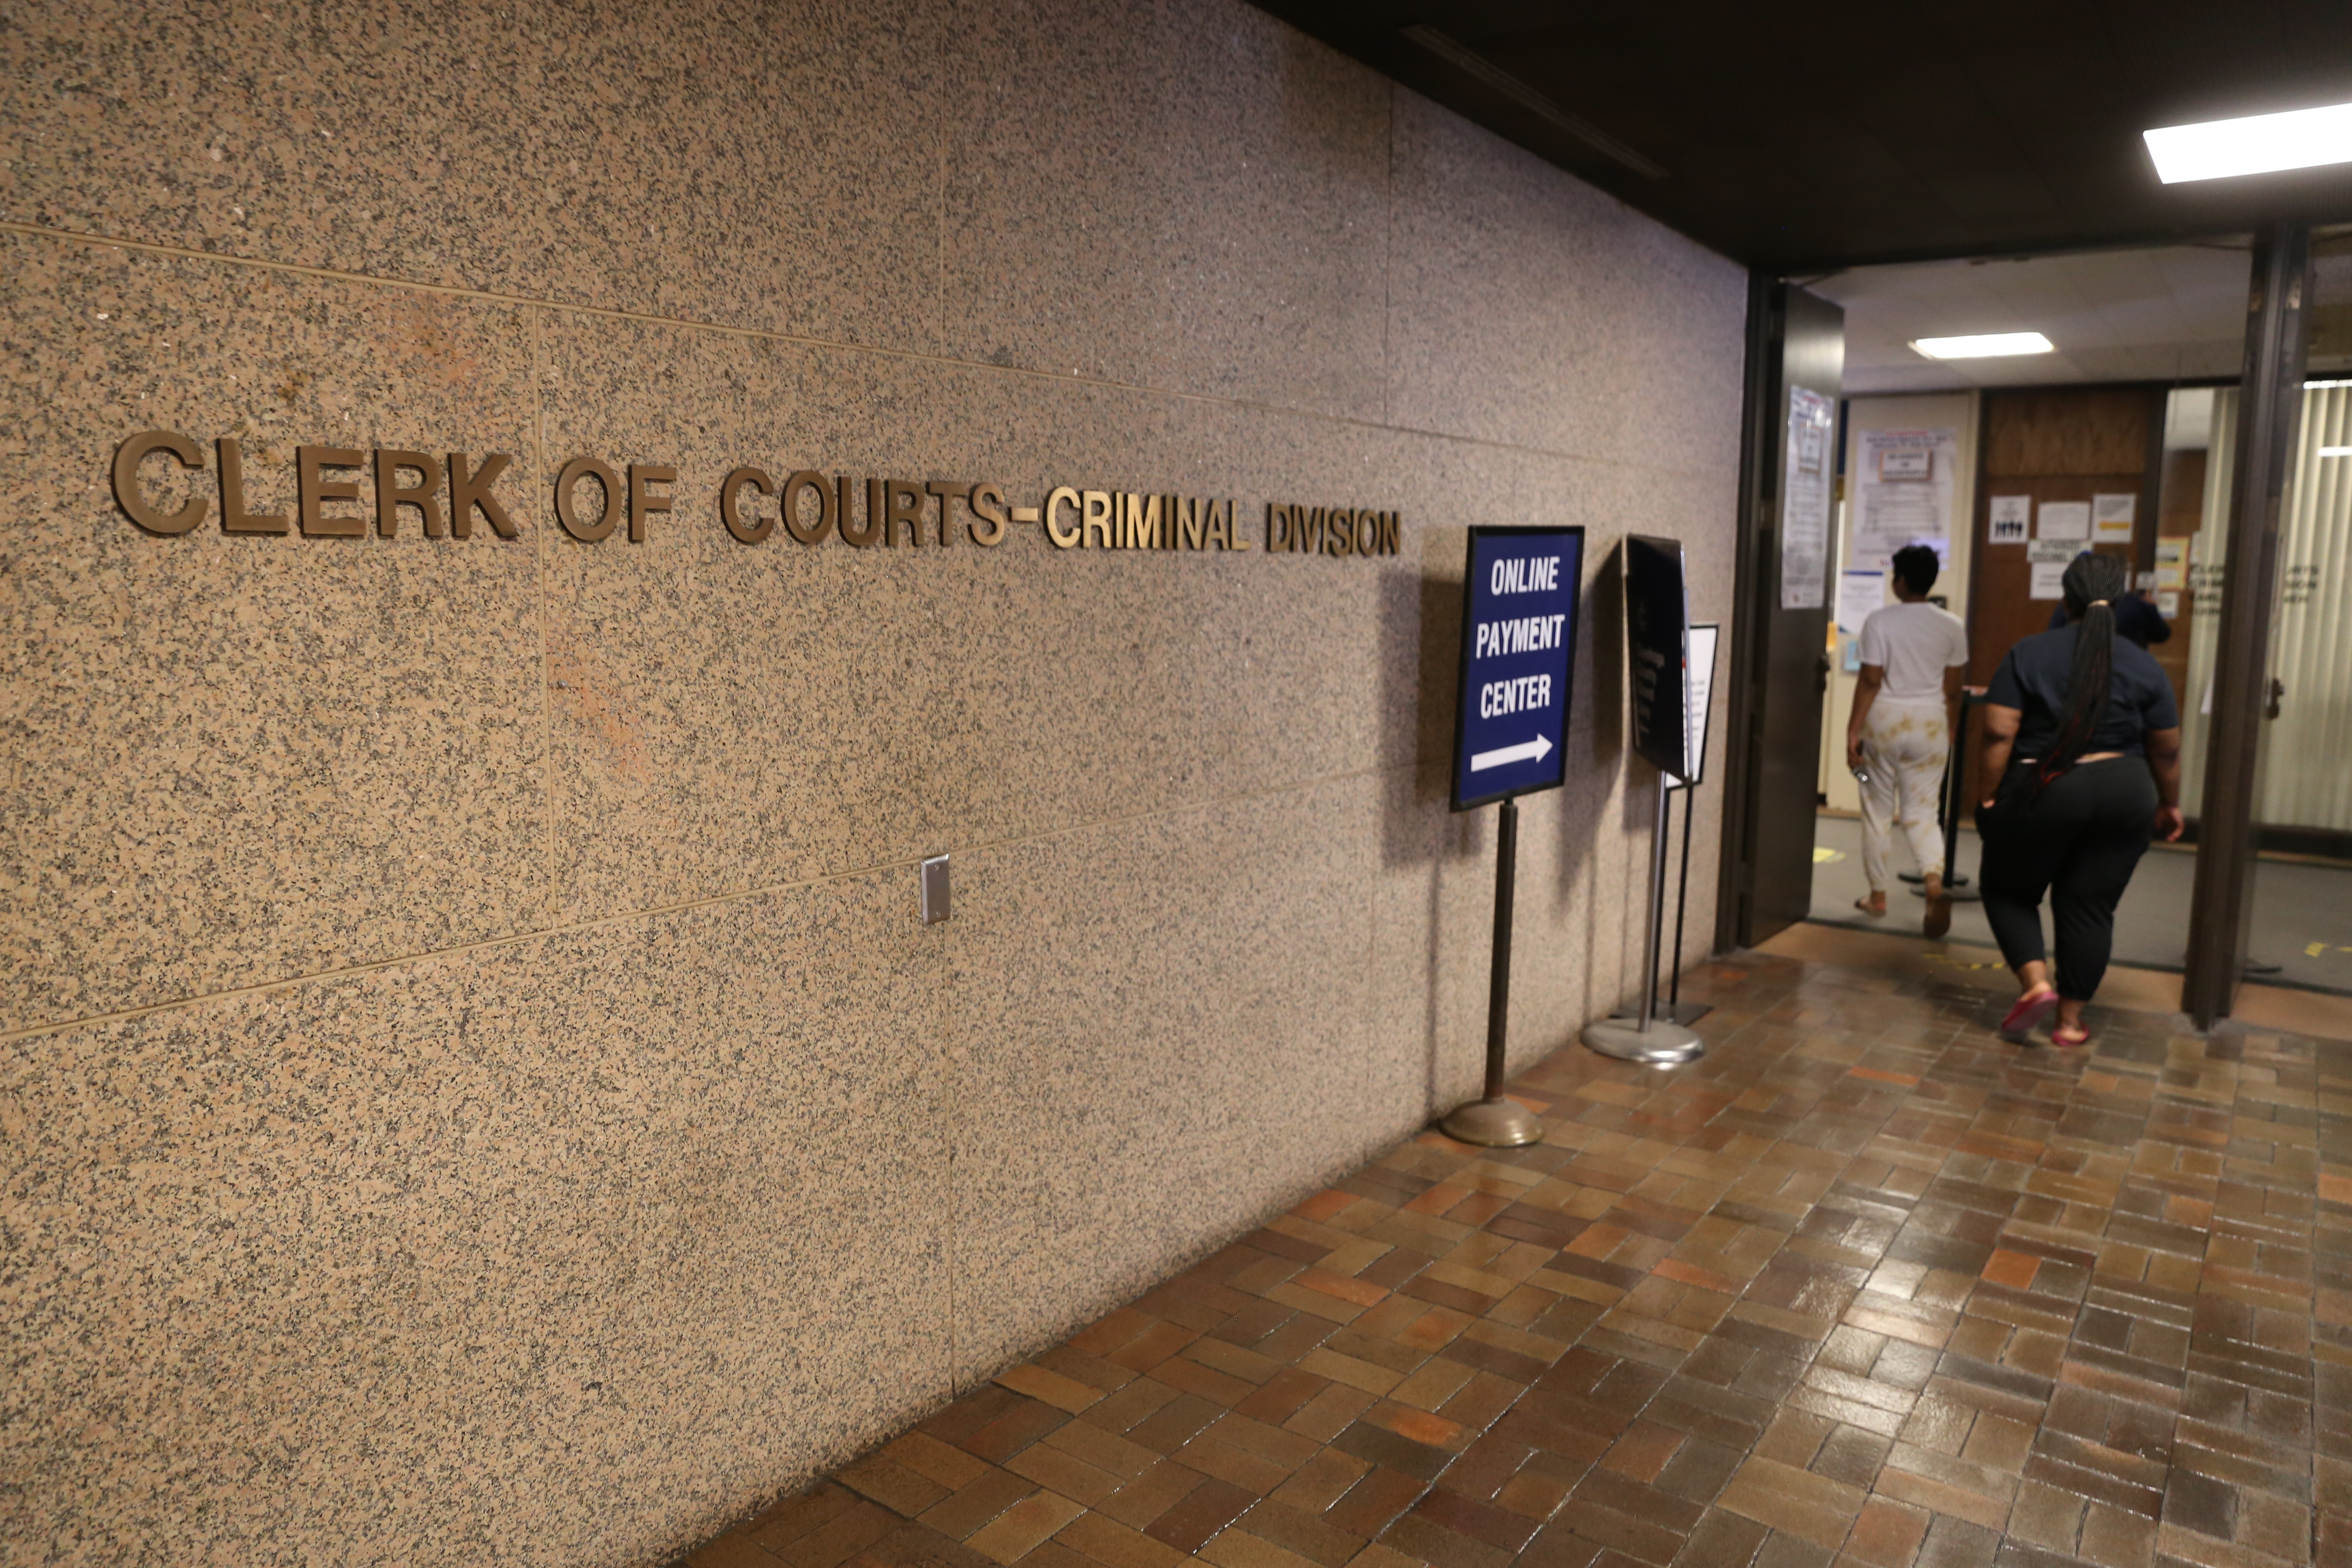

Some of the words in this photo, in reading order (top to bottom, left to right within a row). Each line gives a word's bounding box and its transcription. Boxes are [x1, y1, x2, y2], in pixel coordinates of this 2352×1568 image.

[112, 430, 518, 538] CLERK
[554, 456, 677, 542] OF
[1267, 503, 1401, 557] DIVISION
[1491, 557, 1559, 596] ONLINE
[1476, 615, 1565, 659] PAYMENT
[1480, 674, 1551, 719] CENTER
